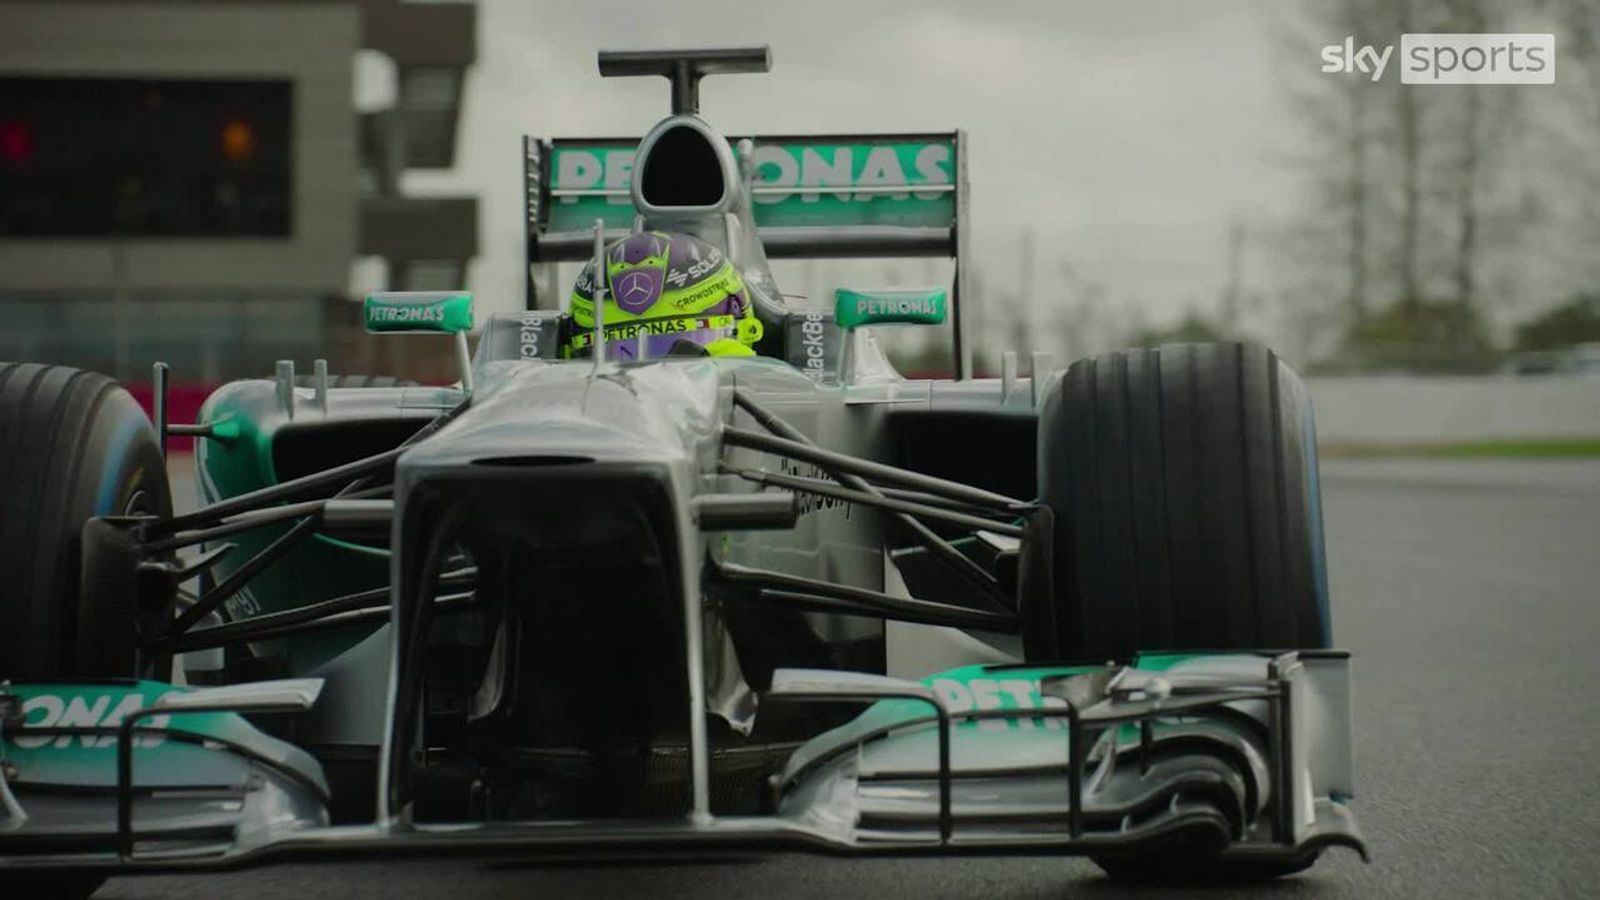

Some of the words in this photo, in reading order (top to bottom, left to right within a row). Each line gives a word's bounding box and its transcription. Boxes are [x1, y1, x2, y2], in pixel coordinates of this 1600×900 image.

[558, 145, 950, 205] PEONAS
[369, 307, 444, 321] PETRONAS
[857, 301, 937, 315] PETRONAS
[520, 317, 541, 361] Blac
